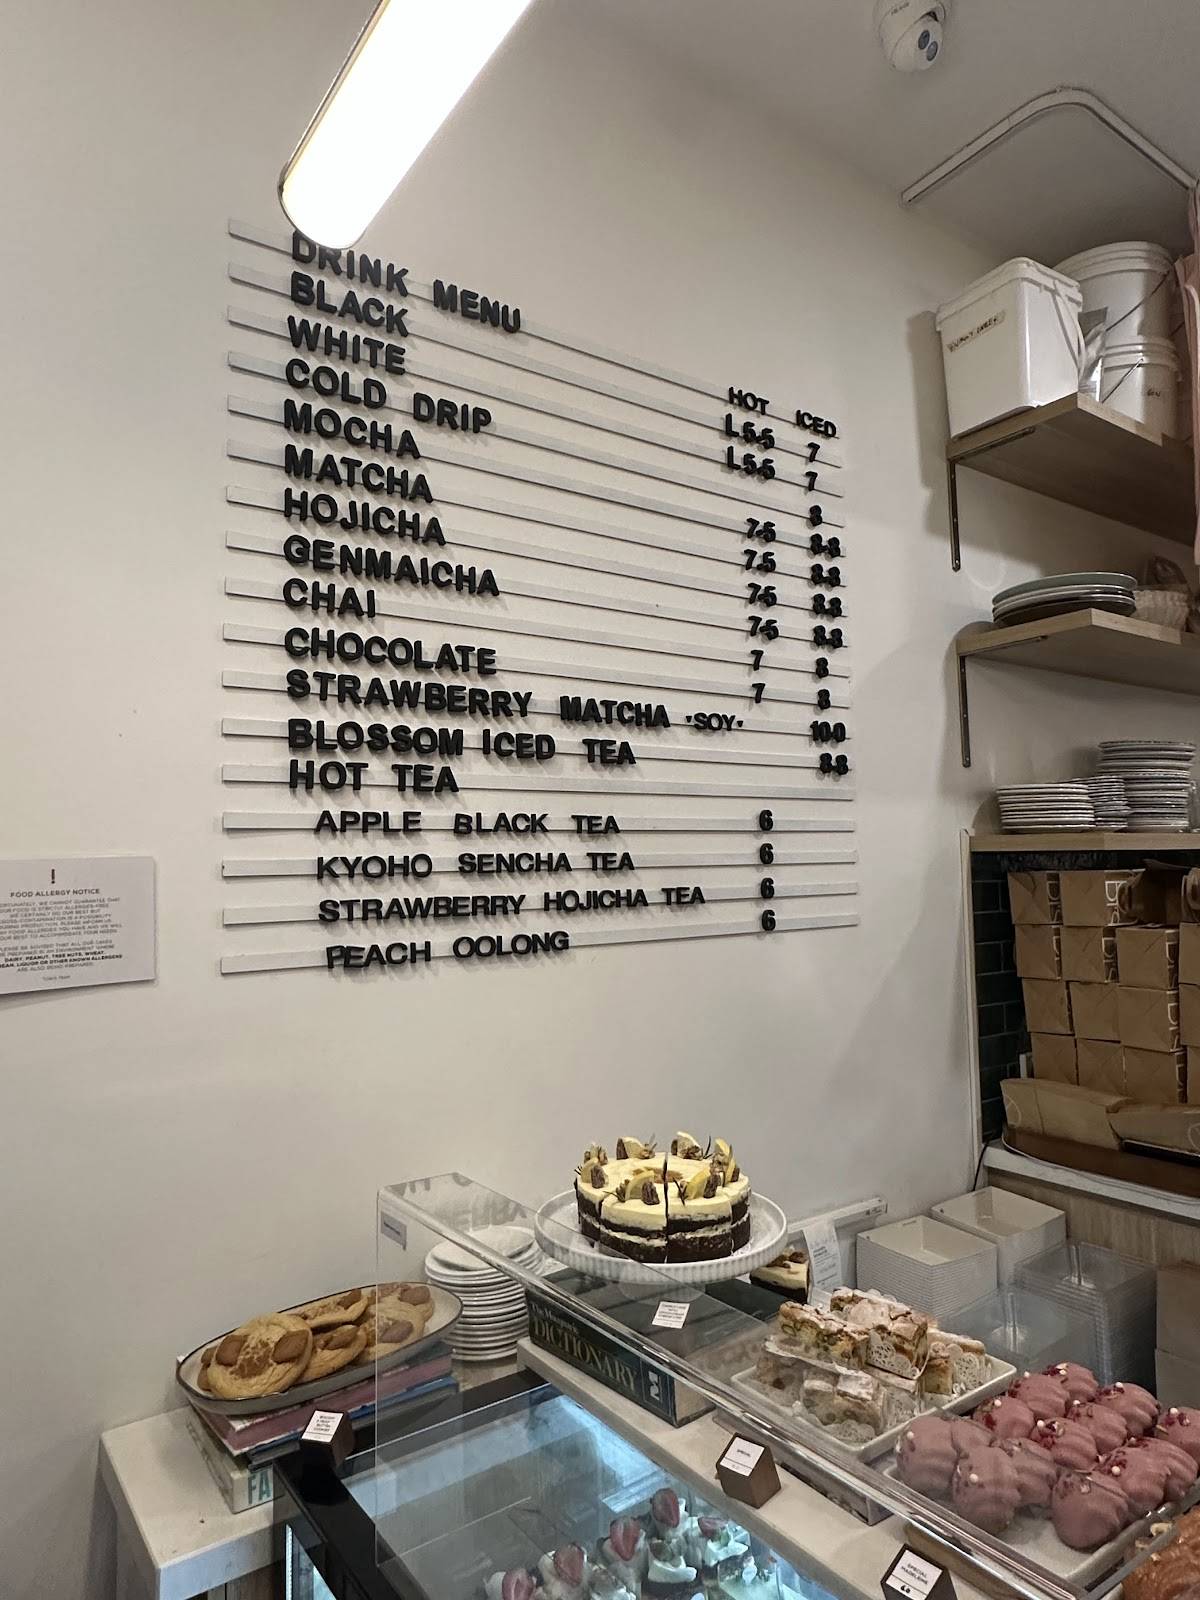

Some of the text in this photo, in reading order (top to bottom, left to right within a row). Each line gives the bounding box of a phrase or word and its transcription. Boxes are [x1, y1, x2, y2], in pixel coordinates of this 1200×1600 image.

[290, 270, 408, 337] BLACK
[292, 230, 520, 333] DRINK MENU
[287, 315, 406, 375] WHITE
[285, 358, 491, 433] COLD DRIP
[729, 386, 837, 437] HOT ICED
[283, 398, 421, 459] MOCHA
[807, 442, 820, 462] 7
[284, 444, 433, 503] MATCHA
[805, 471, 818, 491] 7
[283, 487, 446, 546] HOJICHA
[809, 505, 823, 526] 8
[283, 534, 500, 597] GENMAICHA
[282, 578, 376, 618] CHAI
[284, 627, 497, 675] CHOCOLATE
[750, 649, 829, 678] 7 8
[286, 668, 533, 717] STRAWBERRY
[559, 695, 671, 728] MATCHA
[752, 683, 831, 710] 7 8
[288, 718, 636, 765] BLOSSOM ICED TEA
[289, 759, 460, 793] HOT TEA
[314, 809, 774, 834] APPLE BLACK TEA 6
[316, 843, 774, 880] KYOHO SENCHA TEA 6
[35, 889, 71, 897] ALLERGY
[72, 888, 100, 896] NOTICE
[318, 877, 775, 923] STRAWBERRY HOJICHA TEA 6
[326, 909, 776, 969] PEACH OOLONG 6
[533, 1314, 638, 1391] DICTIONARY
